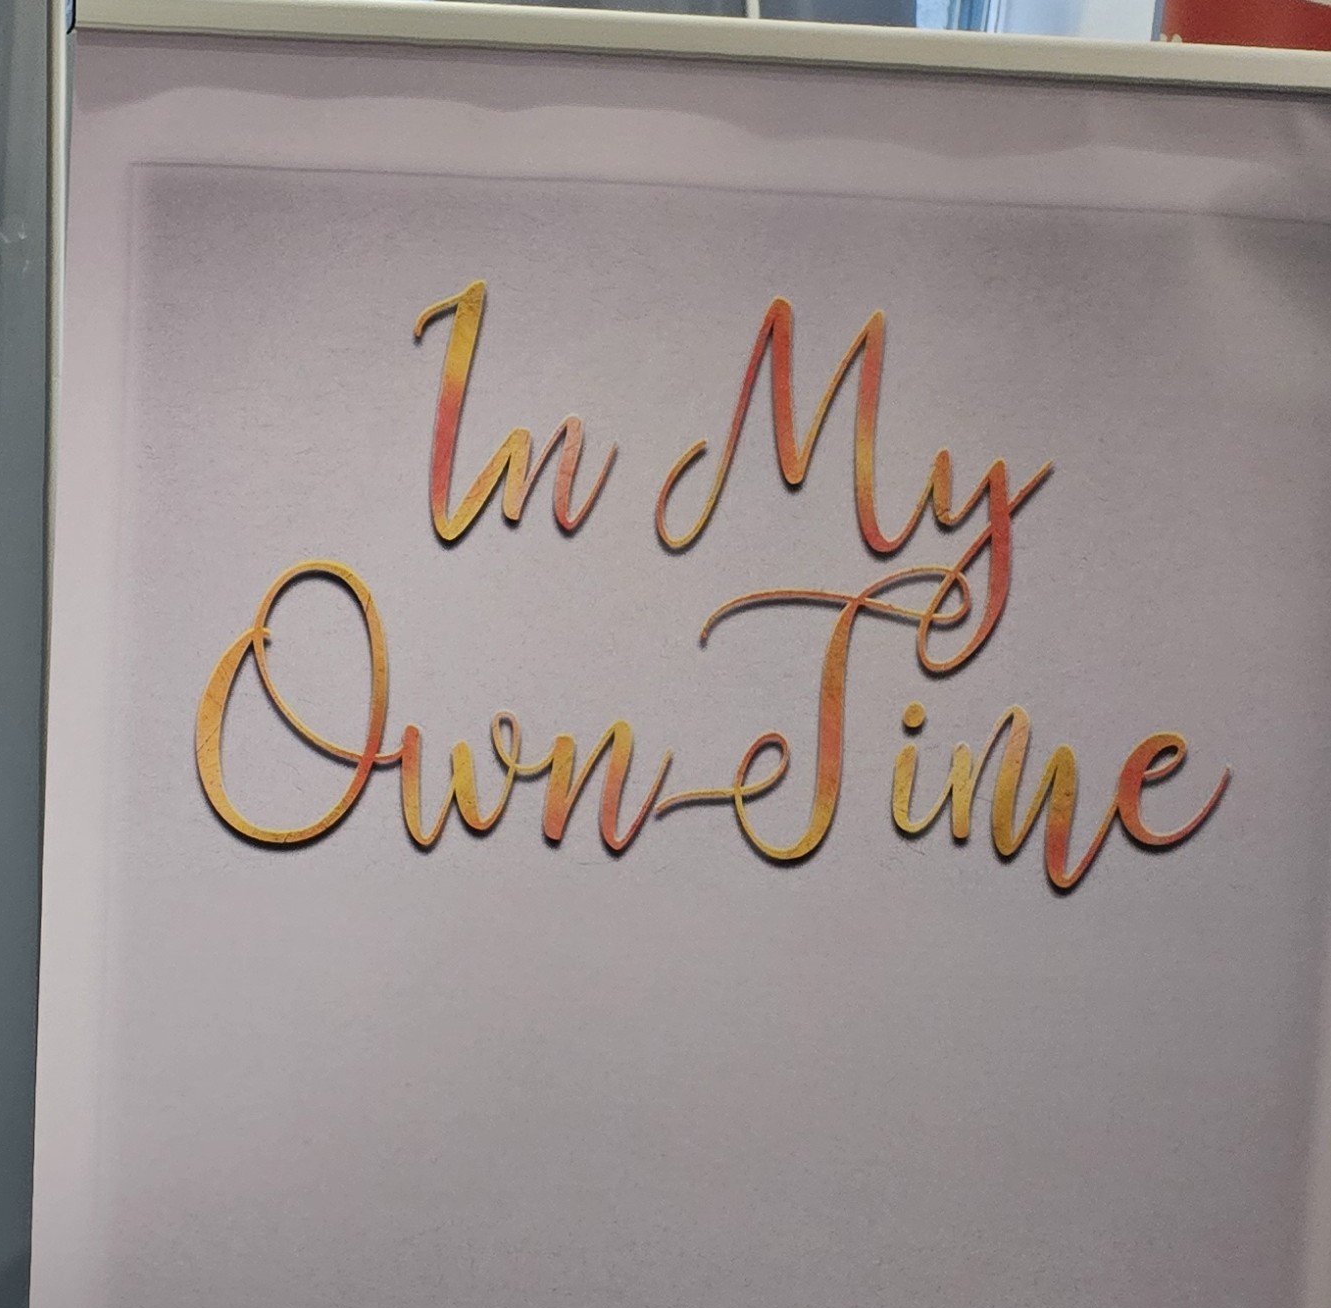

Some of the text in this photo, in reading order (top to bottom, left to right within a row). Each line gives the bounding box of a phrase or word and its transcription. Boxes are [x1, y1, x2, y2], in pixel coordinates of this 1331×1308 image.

[412, 280, 1056, 675] In My
[194, 560, 1232, 892] Own Time
